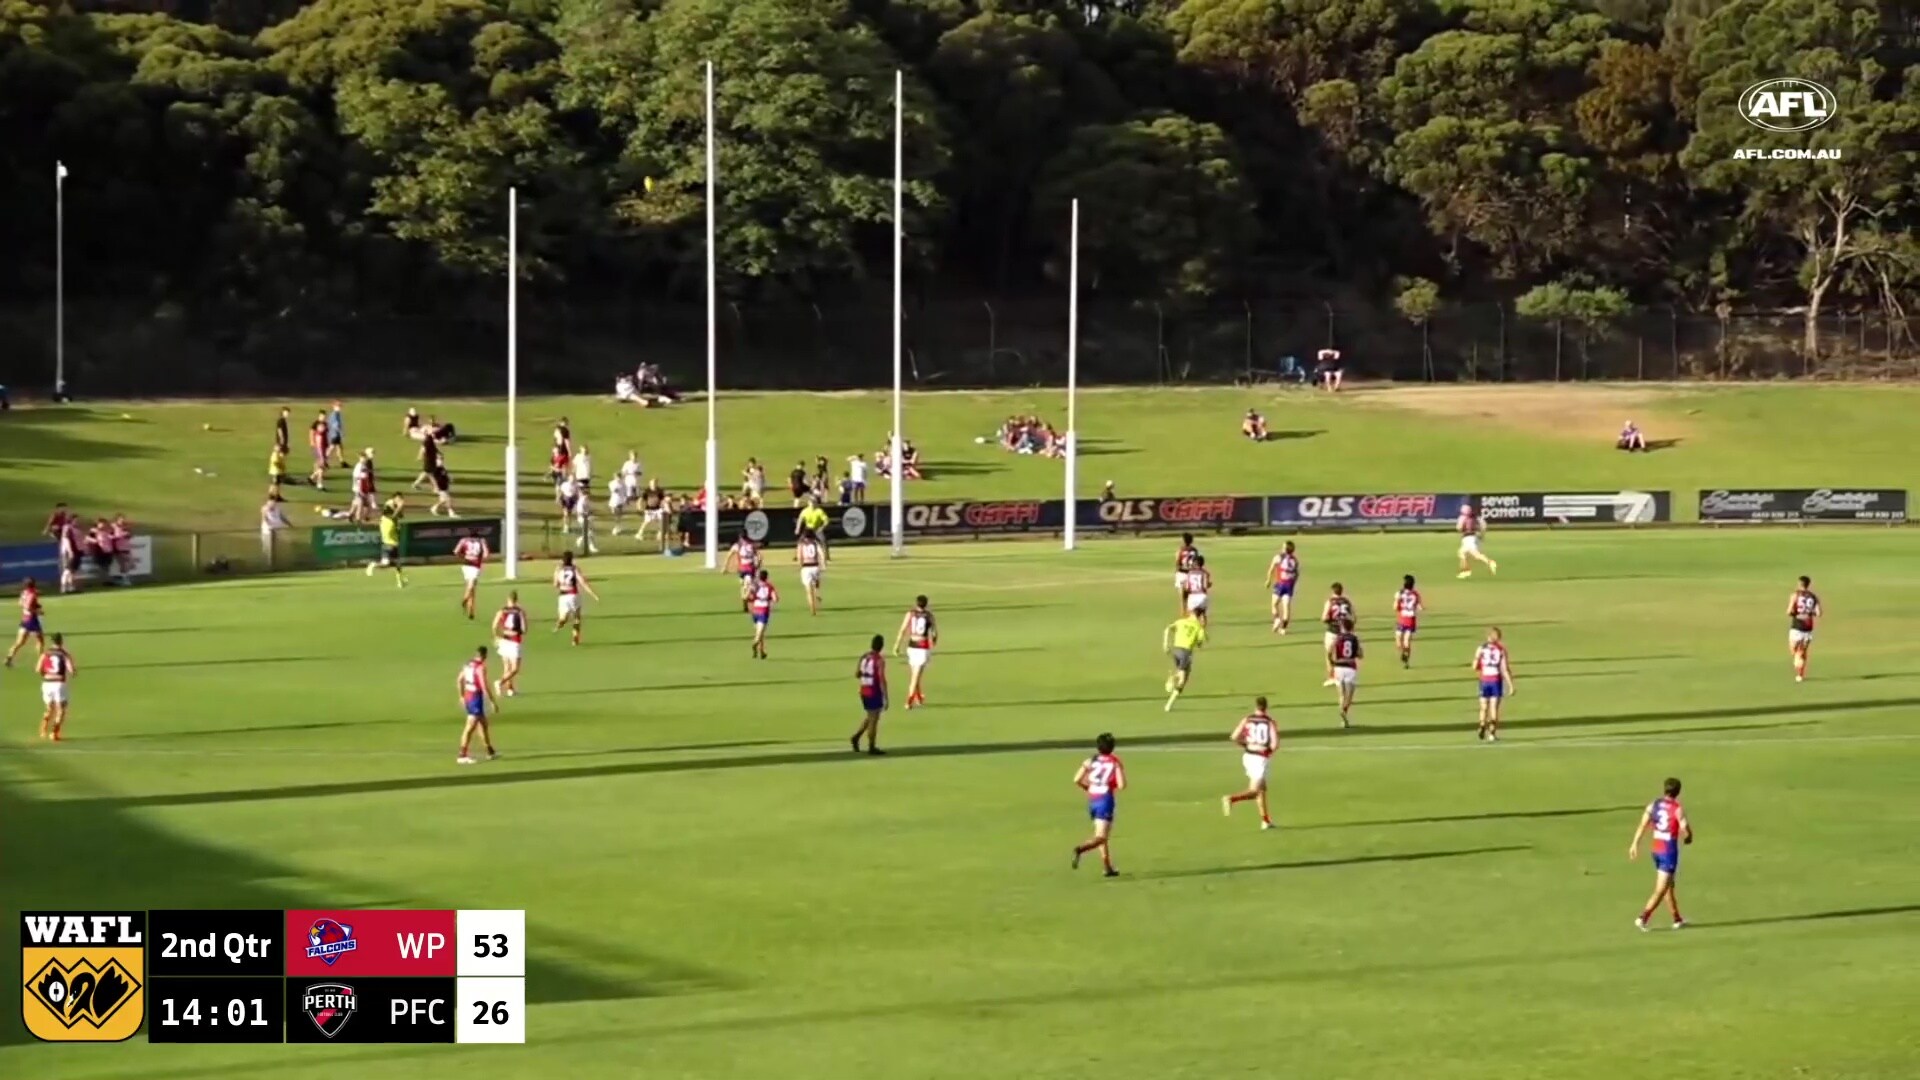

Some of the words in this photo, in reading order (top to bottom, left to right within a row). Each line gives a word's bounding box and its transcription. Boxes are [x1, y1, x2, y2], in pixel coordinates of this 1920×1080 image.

[1100, 500, 1154, 522] QLS
[1298, 497, 1354, 518] QLS
[1481, 495, 1520, 507] seven
[906, 504, 964, 527] QLS
[1480, 506, 1536, 519] patterns
[911, 615, 927, 635] 18
[1342, 640, 1353, 658] 8
[48, 655, 60, 673] 3
[1245, 722, 1269, 744] 30
[1088, 761, 1115, 783] 27
[1655, 809, 1669, 831] 3
